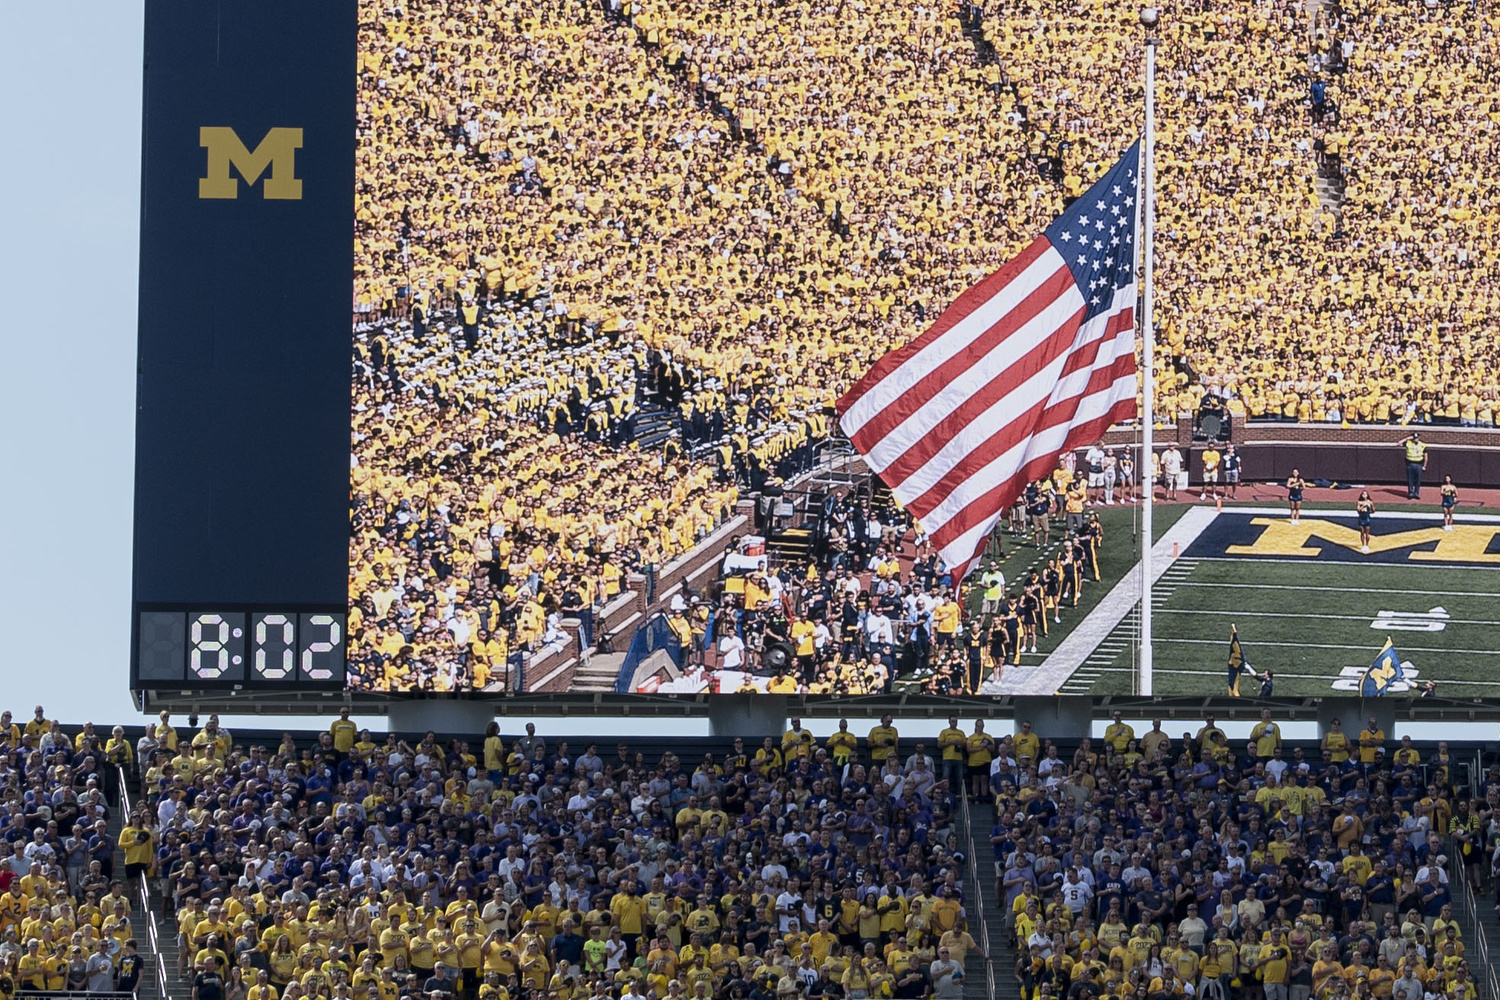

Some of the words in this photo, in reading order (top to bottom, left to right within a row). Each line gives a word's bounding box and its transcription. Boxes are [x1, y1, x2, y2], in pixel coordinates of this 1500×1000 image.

[199, 126, 303, 200] M
[190, 613, 341, 679] 8:02
[825, 904, 833, 918] 6
